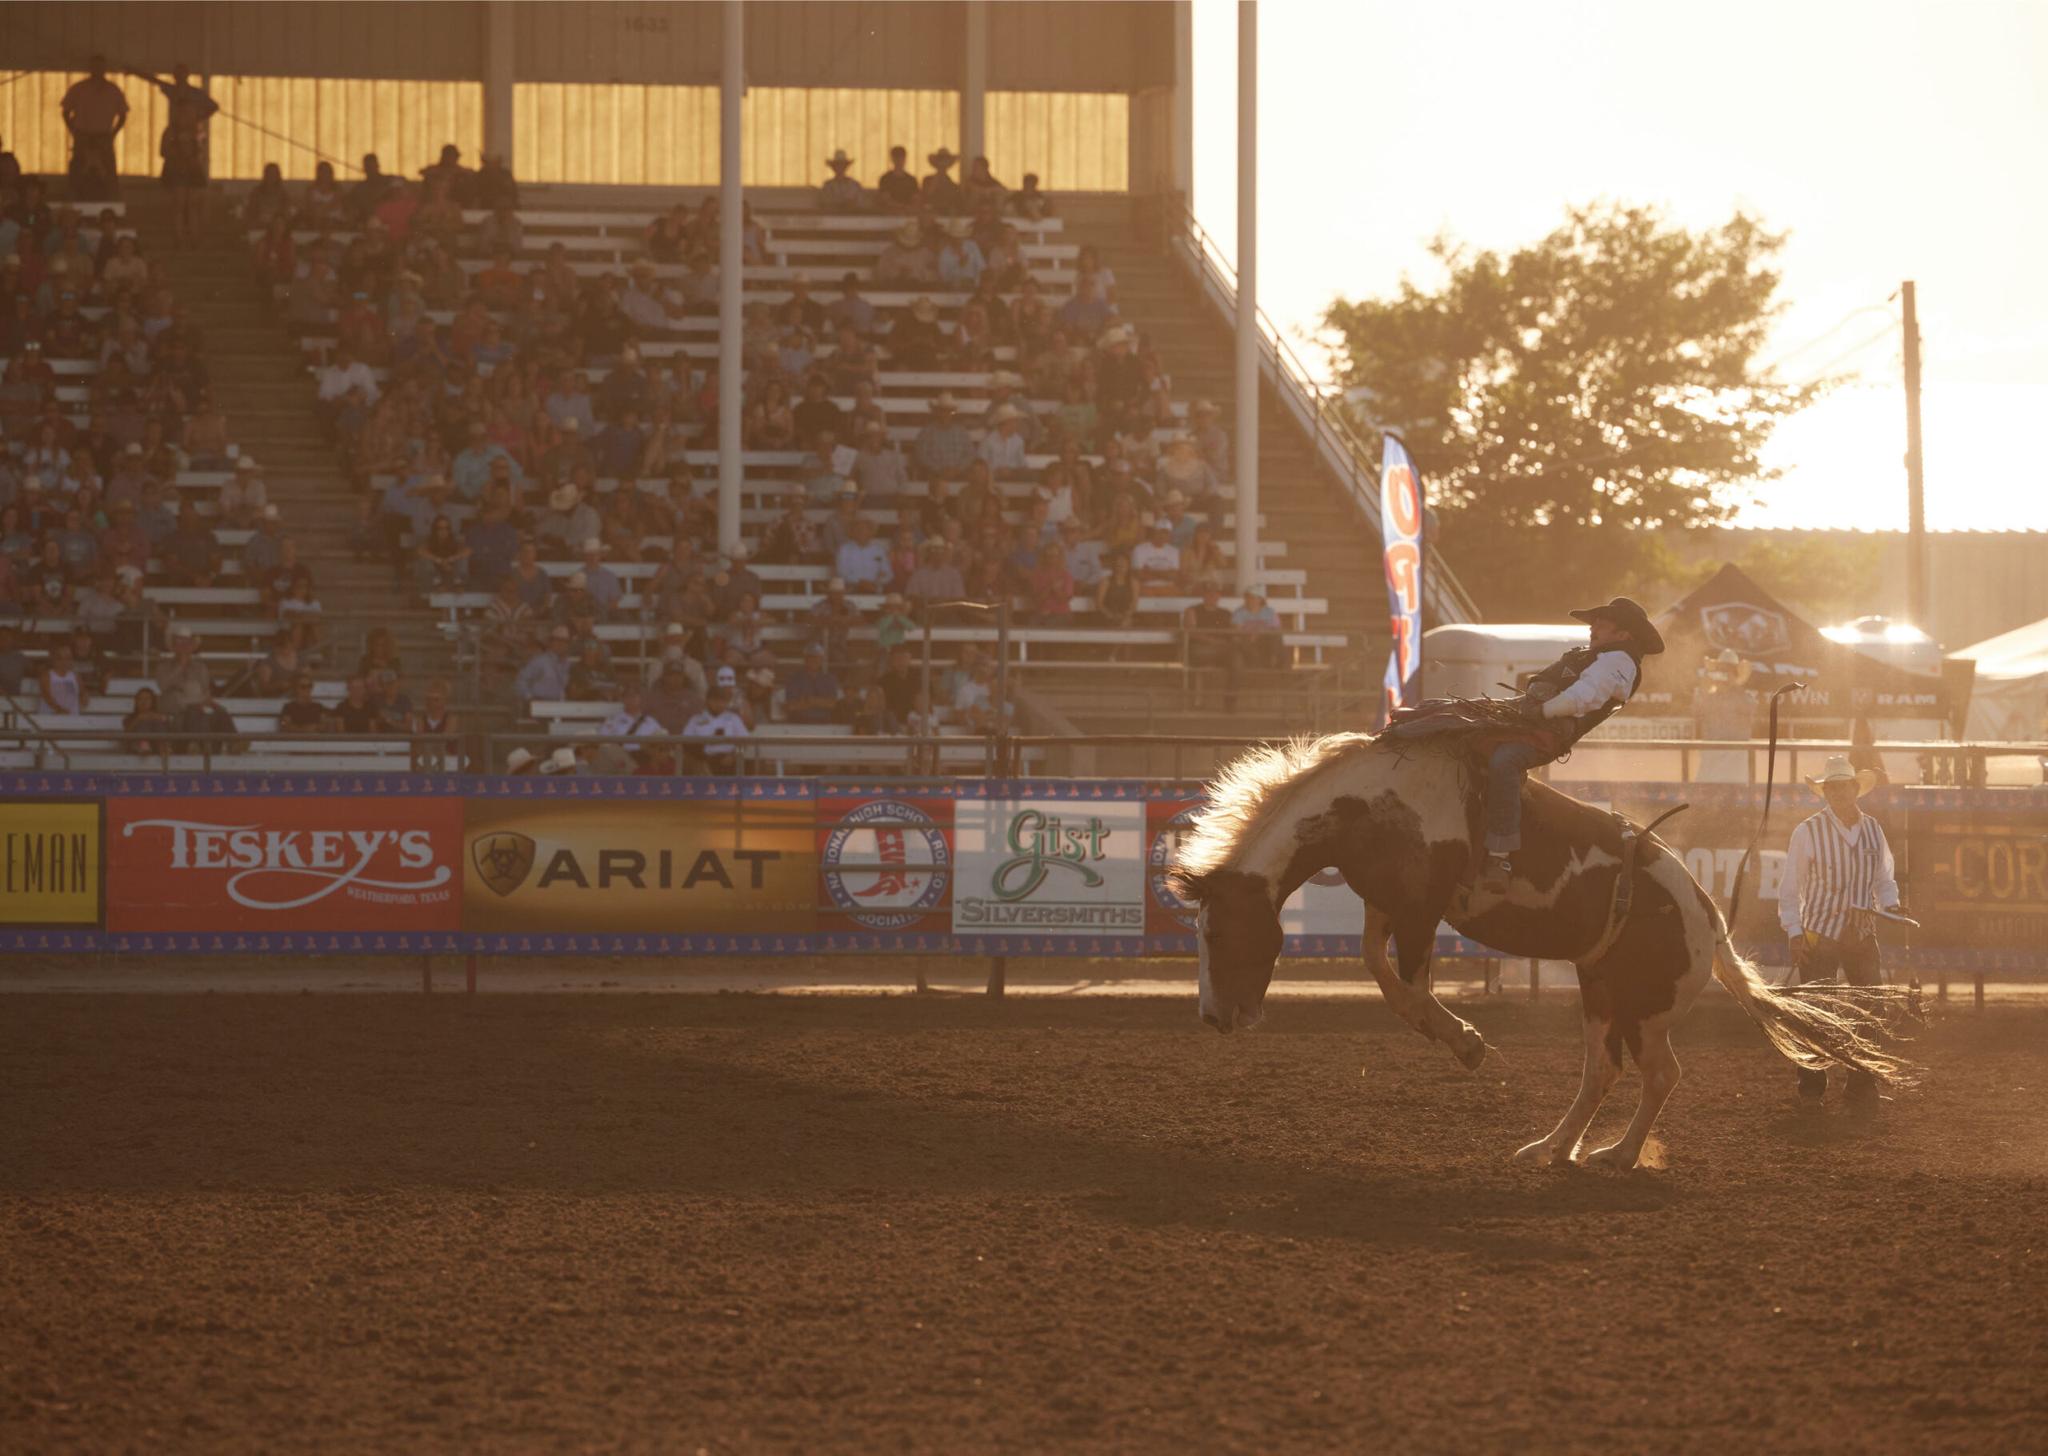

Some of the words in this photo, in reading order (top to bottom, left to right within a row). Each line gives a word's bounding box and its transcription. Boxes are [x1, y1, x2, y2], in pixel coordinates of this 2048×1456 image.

[1631, 692, 1672, 704] AM
[1876, 694, 1937, 705] RAM
[850, 804, 882, 823] HIGH
[887, 804, 935, 840] SCHOL
[536, 848, 781, 889] ARIAT
[992, 809, 1111, 901] Gist
[960, 896, 1141, 923] SILVERSMITHS
